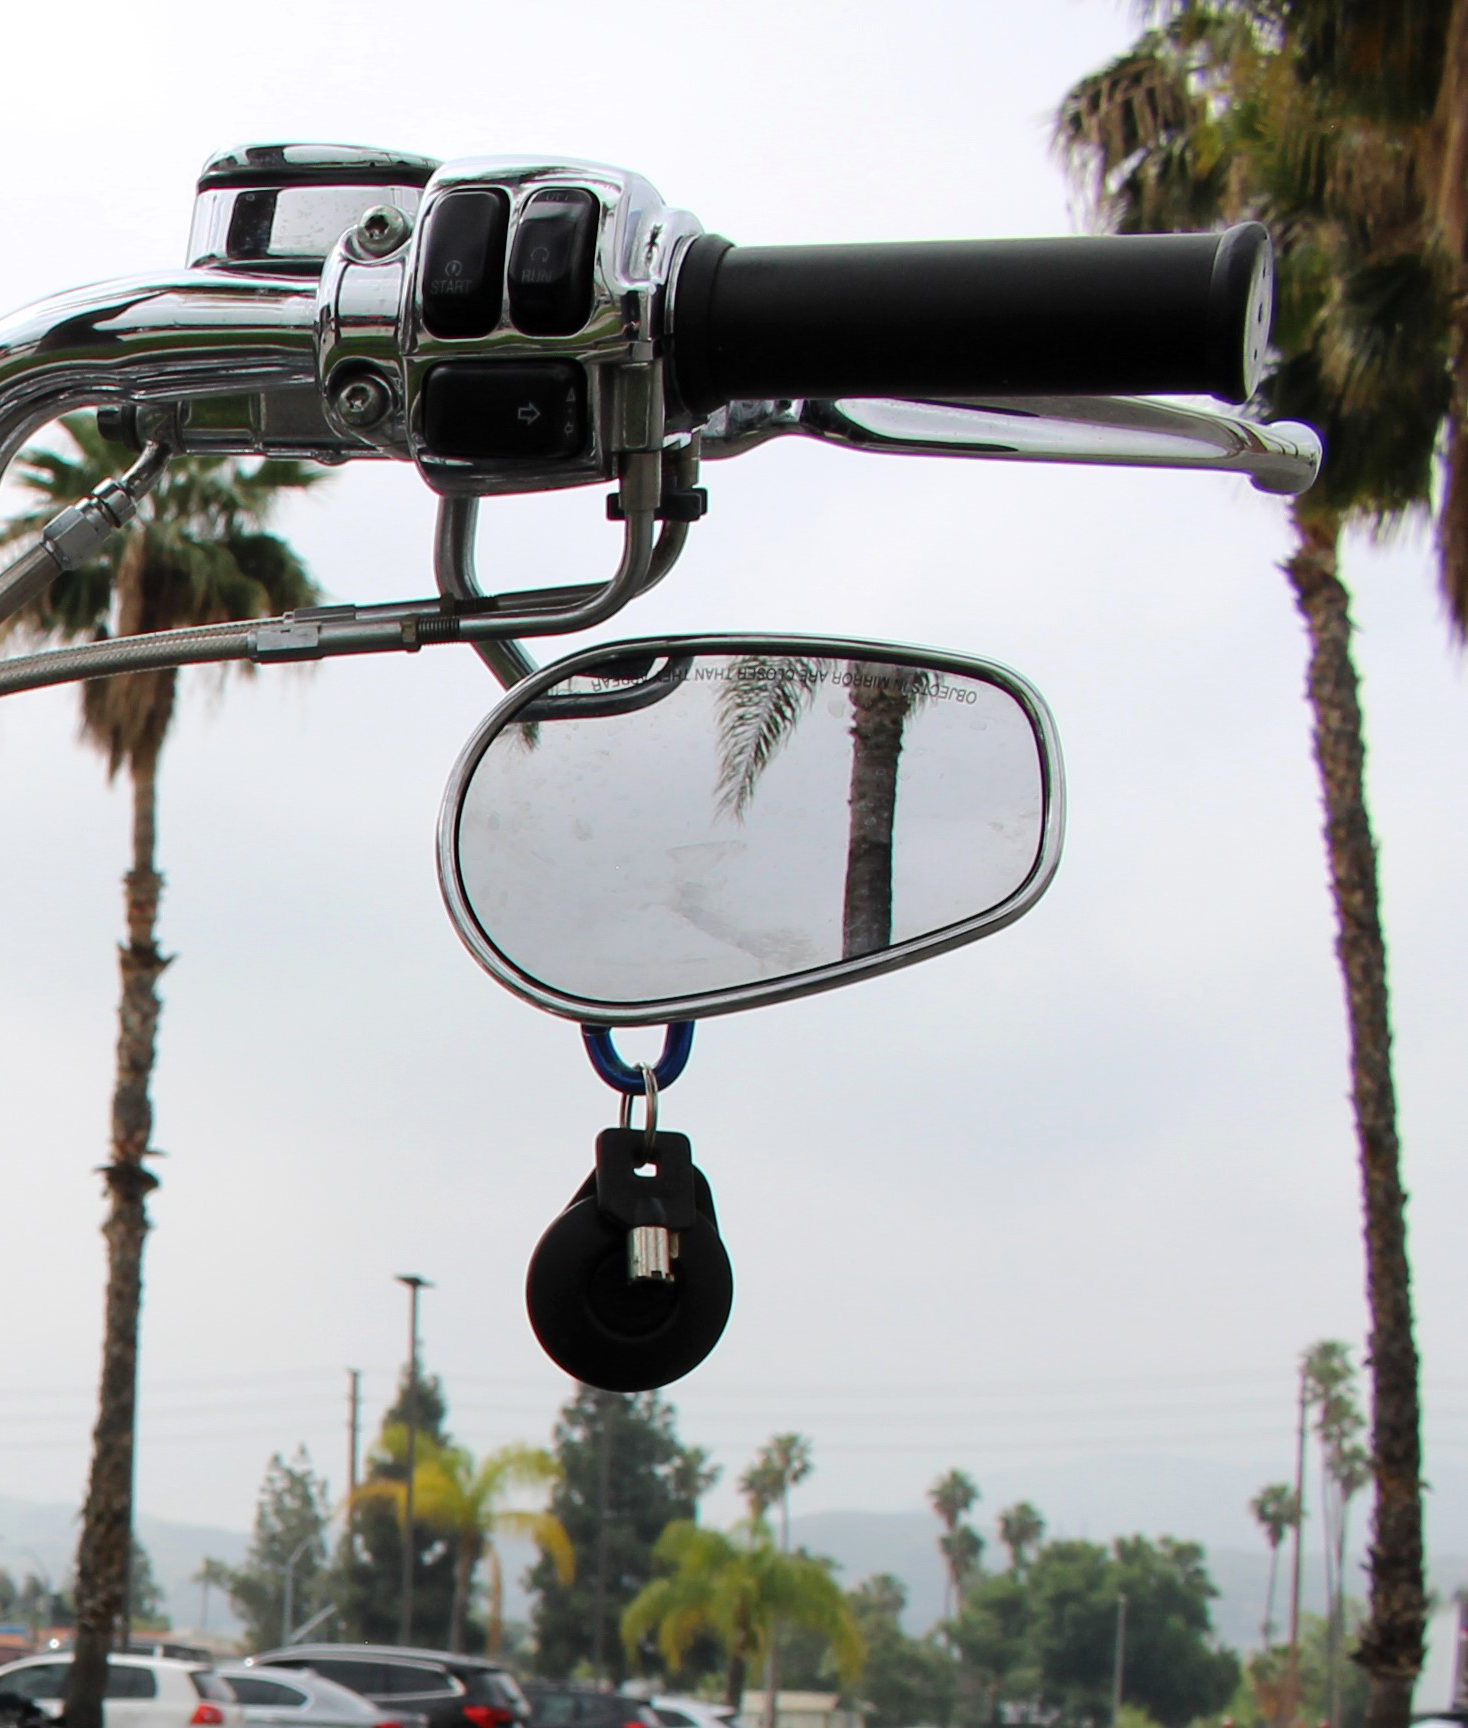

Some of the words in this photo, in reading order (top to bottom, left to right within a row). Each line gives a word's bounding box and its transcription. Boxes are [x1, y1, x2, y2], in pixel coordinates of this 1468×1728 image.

[520, 269, 553, 284] RUN
[429, 279, 473, 296] START
[694, 667, 733, 682] THAN
[737, 666, 795, 683] CLOSER
[800, 667, 829, 684] ARE
[831, 671, 891, 690] MIRROR
[893, 676, 908, 693] IN
[912, 681, 977, 705] OBJECTS
